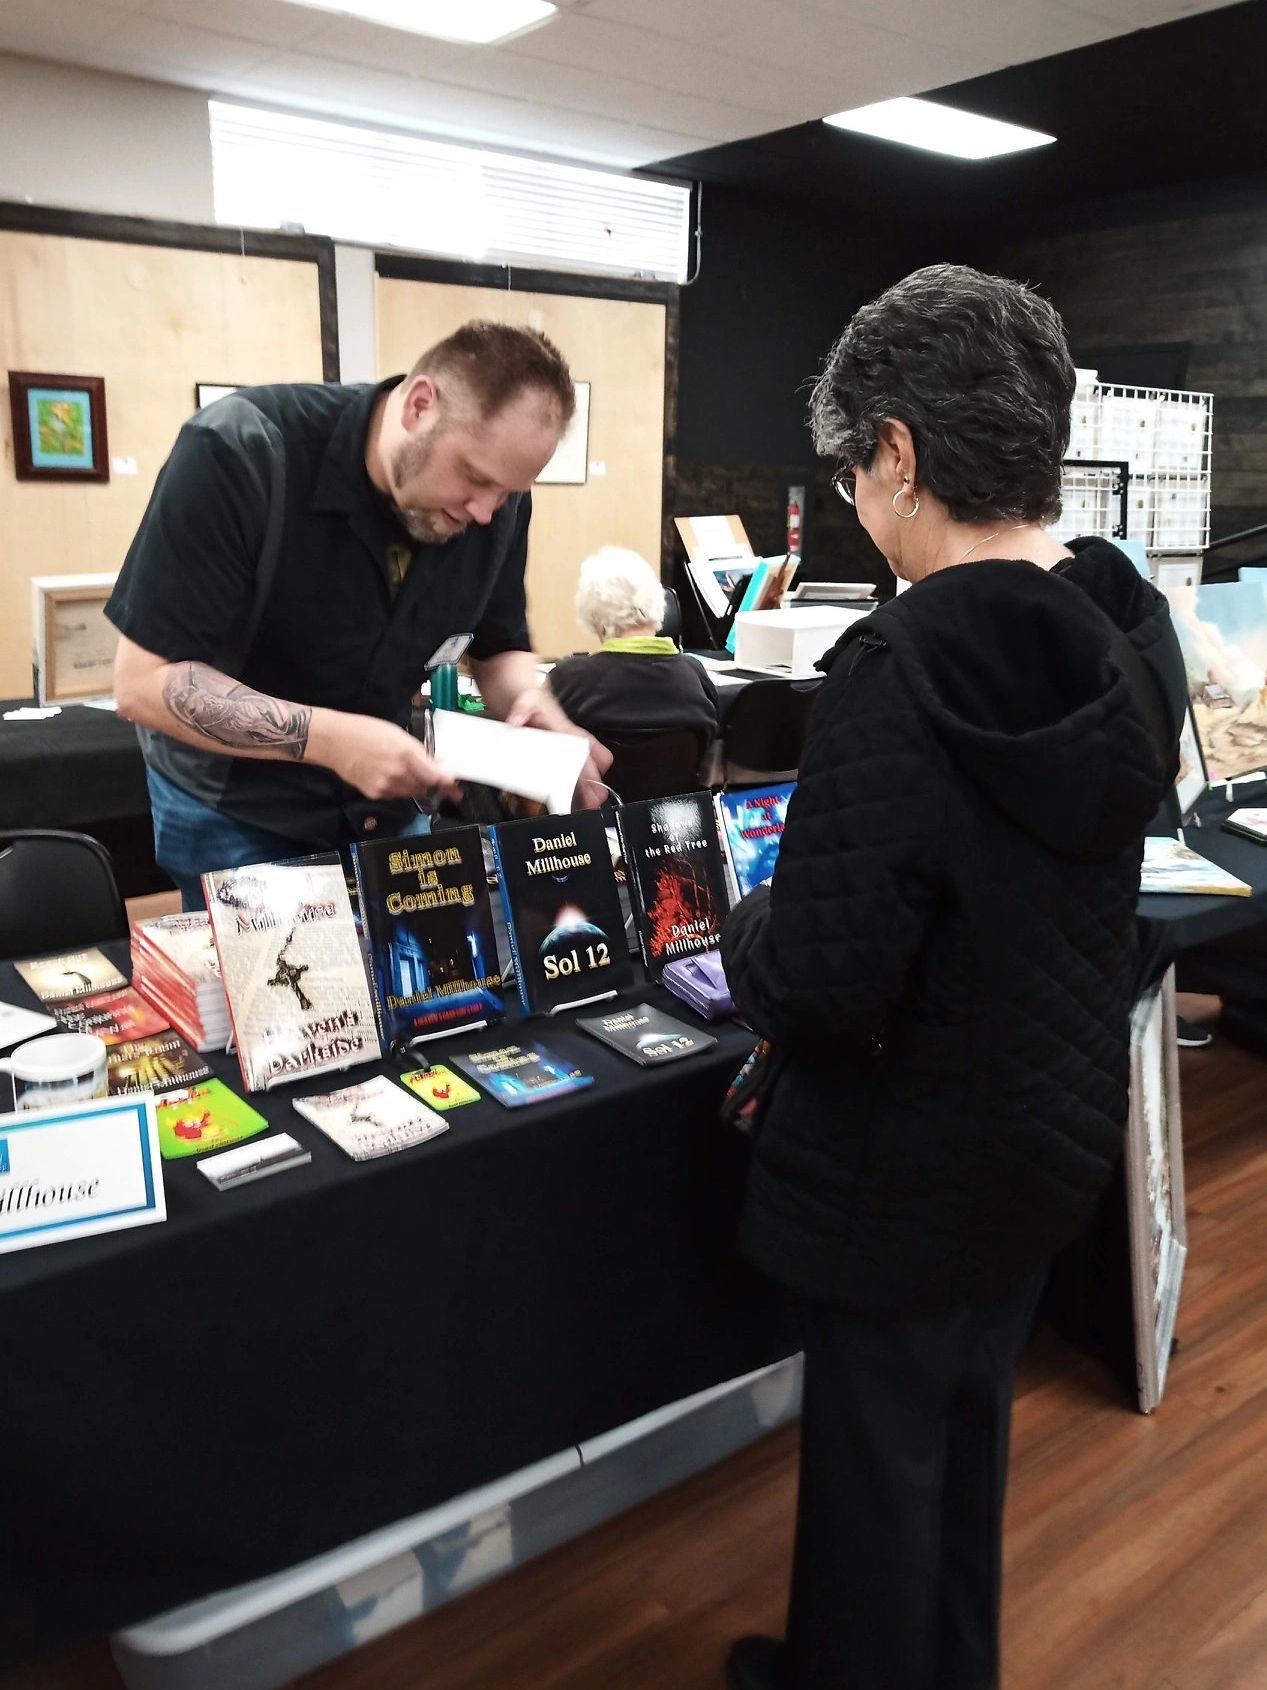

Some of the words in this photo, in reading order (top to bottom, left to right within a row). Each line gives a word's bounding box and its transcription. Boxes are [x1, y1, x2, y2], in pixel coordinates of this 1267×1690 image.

[746, 800, 753, 810] A
[753, 796, 780, 809] Night
[532, 831, 577, 854] Daniel
[645, 846, 662, 859] the
[665, 842, 682, 856] Red
[685, 838, 708, 851] Tree
[388, 847, 462, 875] Simon
[525, 852, 592, 877] Millhouse
[418, 866, 438, 890] is
[386, 884, 475, 915] Coming
[671, 917, 710, 938] Daniel
[543, 949, 581, 981] Sol
[585, 942, 611, 968] 12
[386, 988, 433, 1010] Daniel
[435, 974, 503, 997] Millhouse
